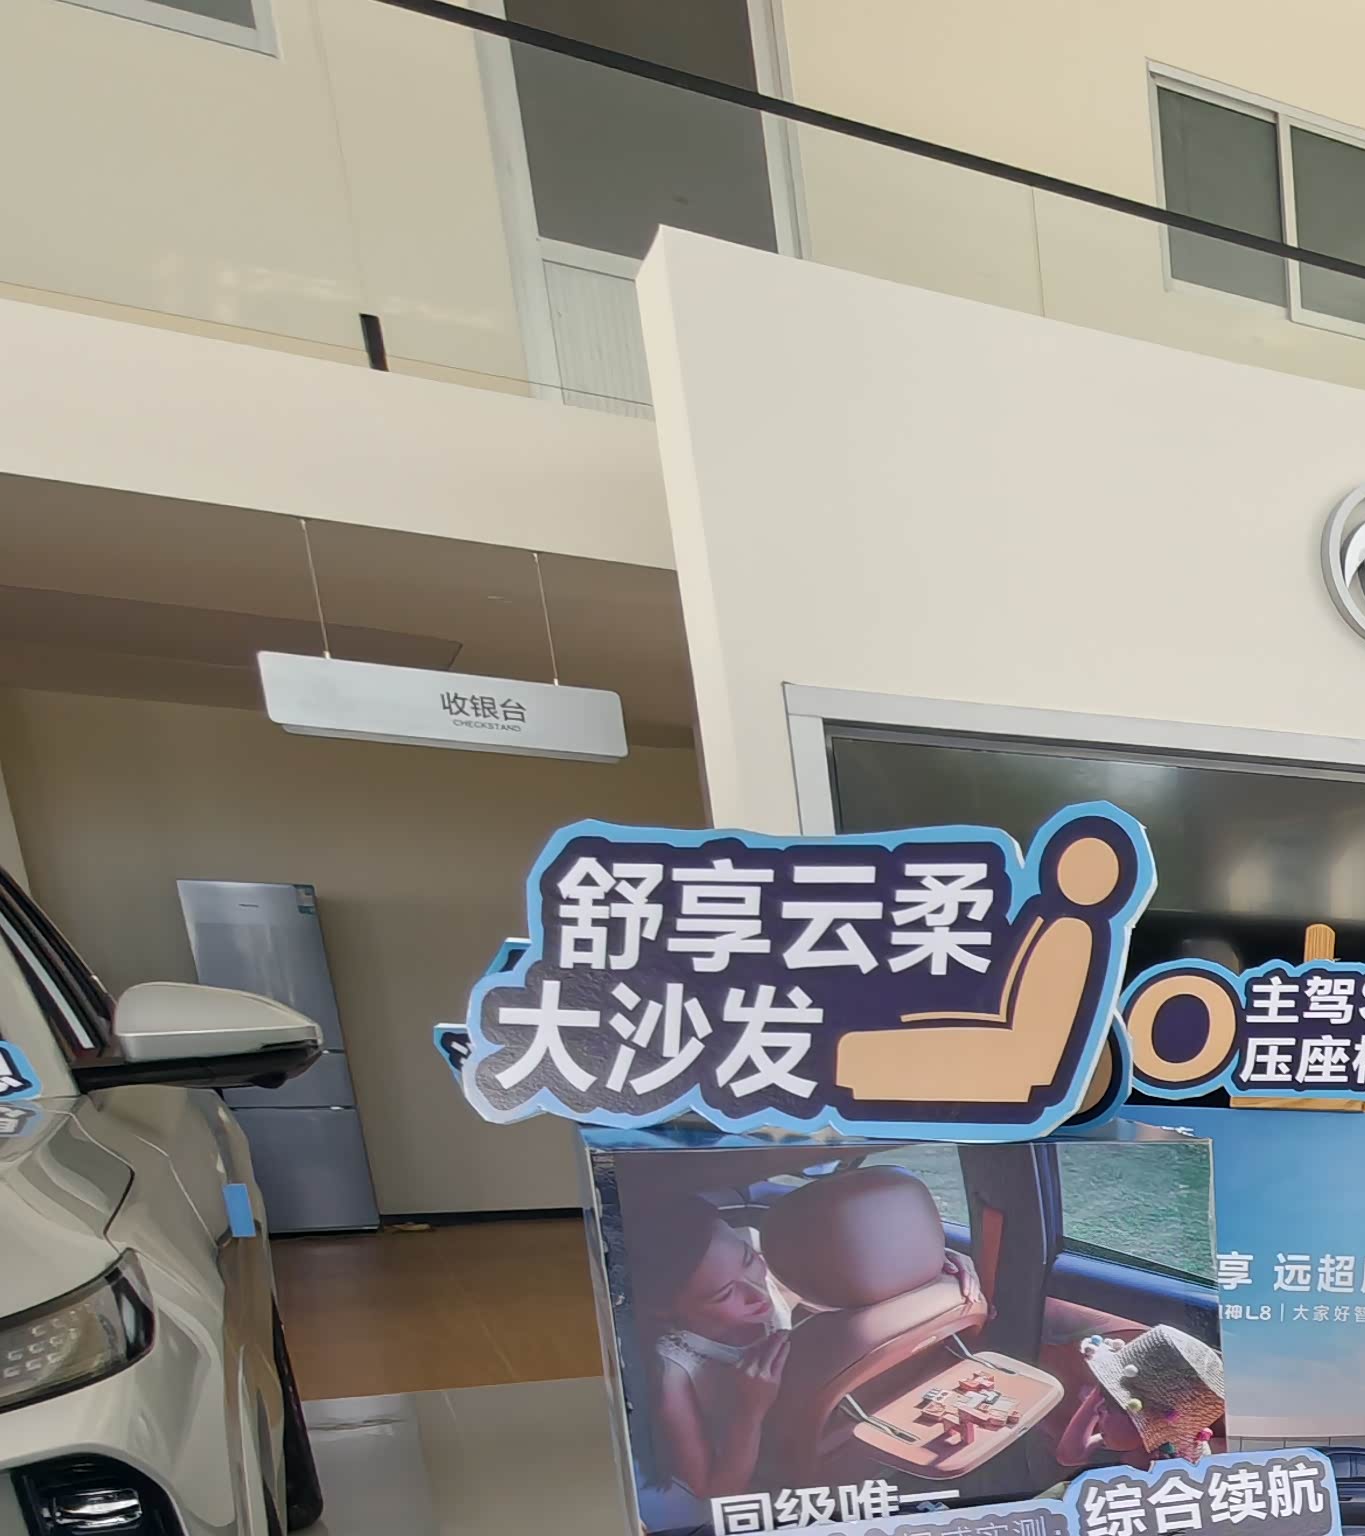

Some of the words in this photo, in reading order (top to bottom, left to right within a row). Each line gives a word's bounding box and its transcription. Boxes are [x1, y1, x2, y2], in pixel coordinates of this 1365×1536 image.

[440, 692, 526, 722] 收银台
[453, 719, 521, 732] CHECKSTAND
[556, 856, 993, 976] 舒享云柔
[494, 980, 824, 1098] 大沙发
[1216, 1251, 1254, 1291] 享
[710, 1478, 960, 1536] 同级唯一
